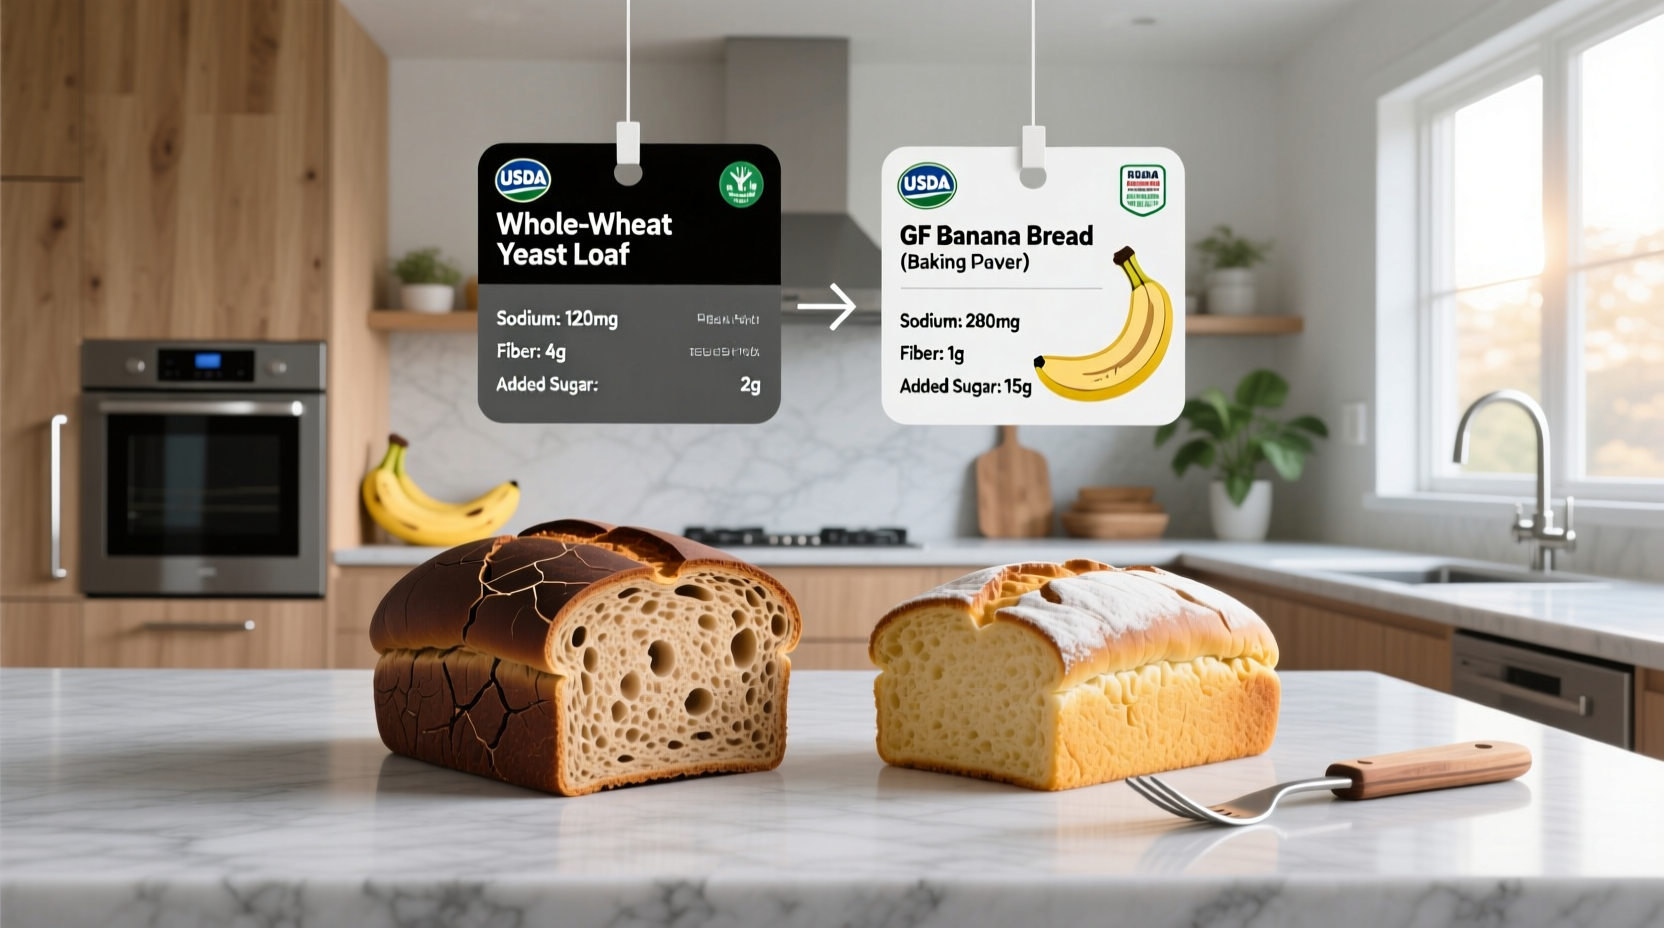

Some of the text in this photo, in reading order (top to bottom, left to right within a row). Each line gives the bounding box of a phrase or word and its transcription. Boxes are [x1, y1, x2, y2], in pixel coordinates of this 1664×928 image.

[500, 169, 547, 186] USDA
[904, 174, 951, 192] USDA
[497, 212, 672, 235] Whole-Wheat
[900, 225, 1093, 245] GF Banana Bread
[497, 242, 630, 265] Yeast Loaf
[901, 252, 966, 273] (Baking
[497, 310, 618, 330] Sodium: 120mg
[901, 313, 1019, 333] Sodium: 280mg
[498, 342, 566, 363] Fiber: 4g
[901, 345, 964, 365] Fiber: 1g
[497, 376, 598, 395] Added Sugar:
[741, 376, 760, 396] 2g
[900, 377, 1031, 398] Added Sugar: 15g
